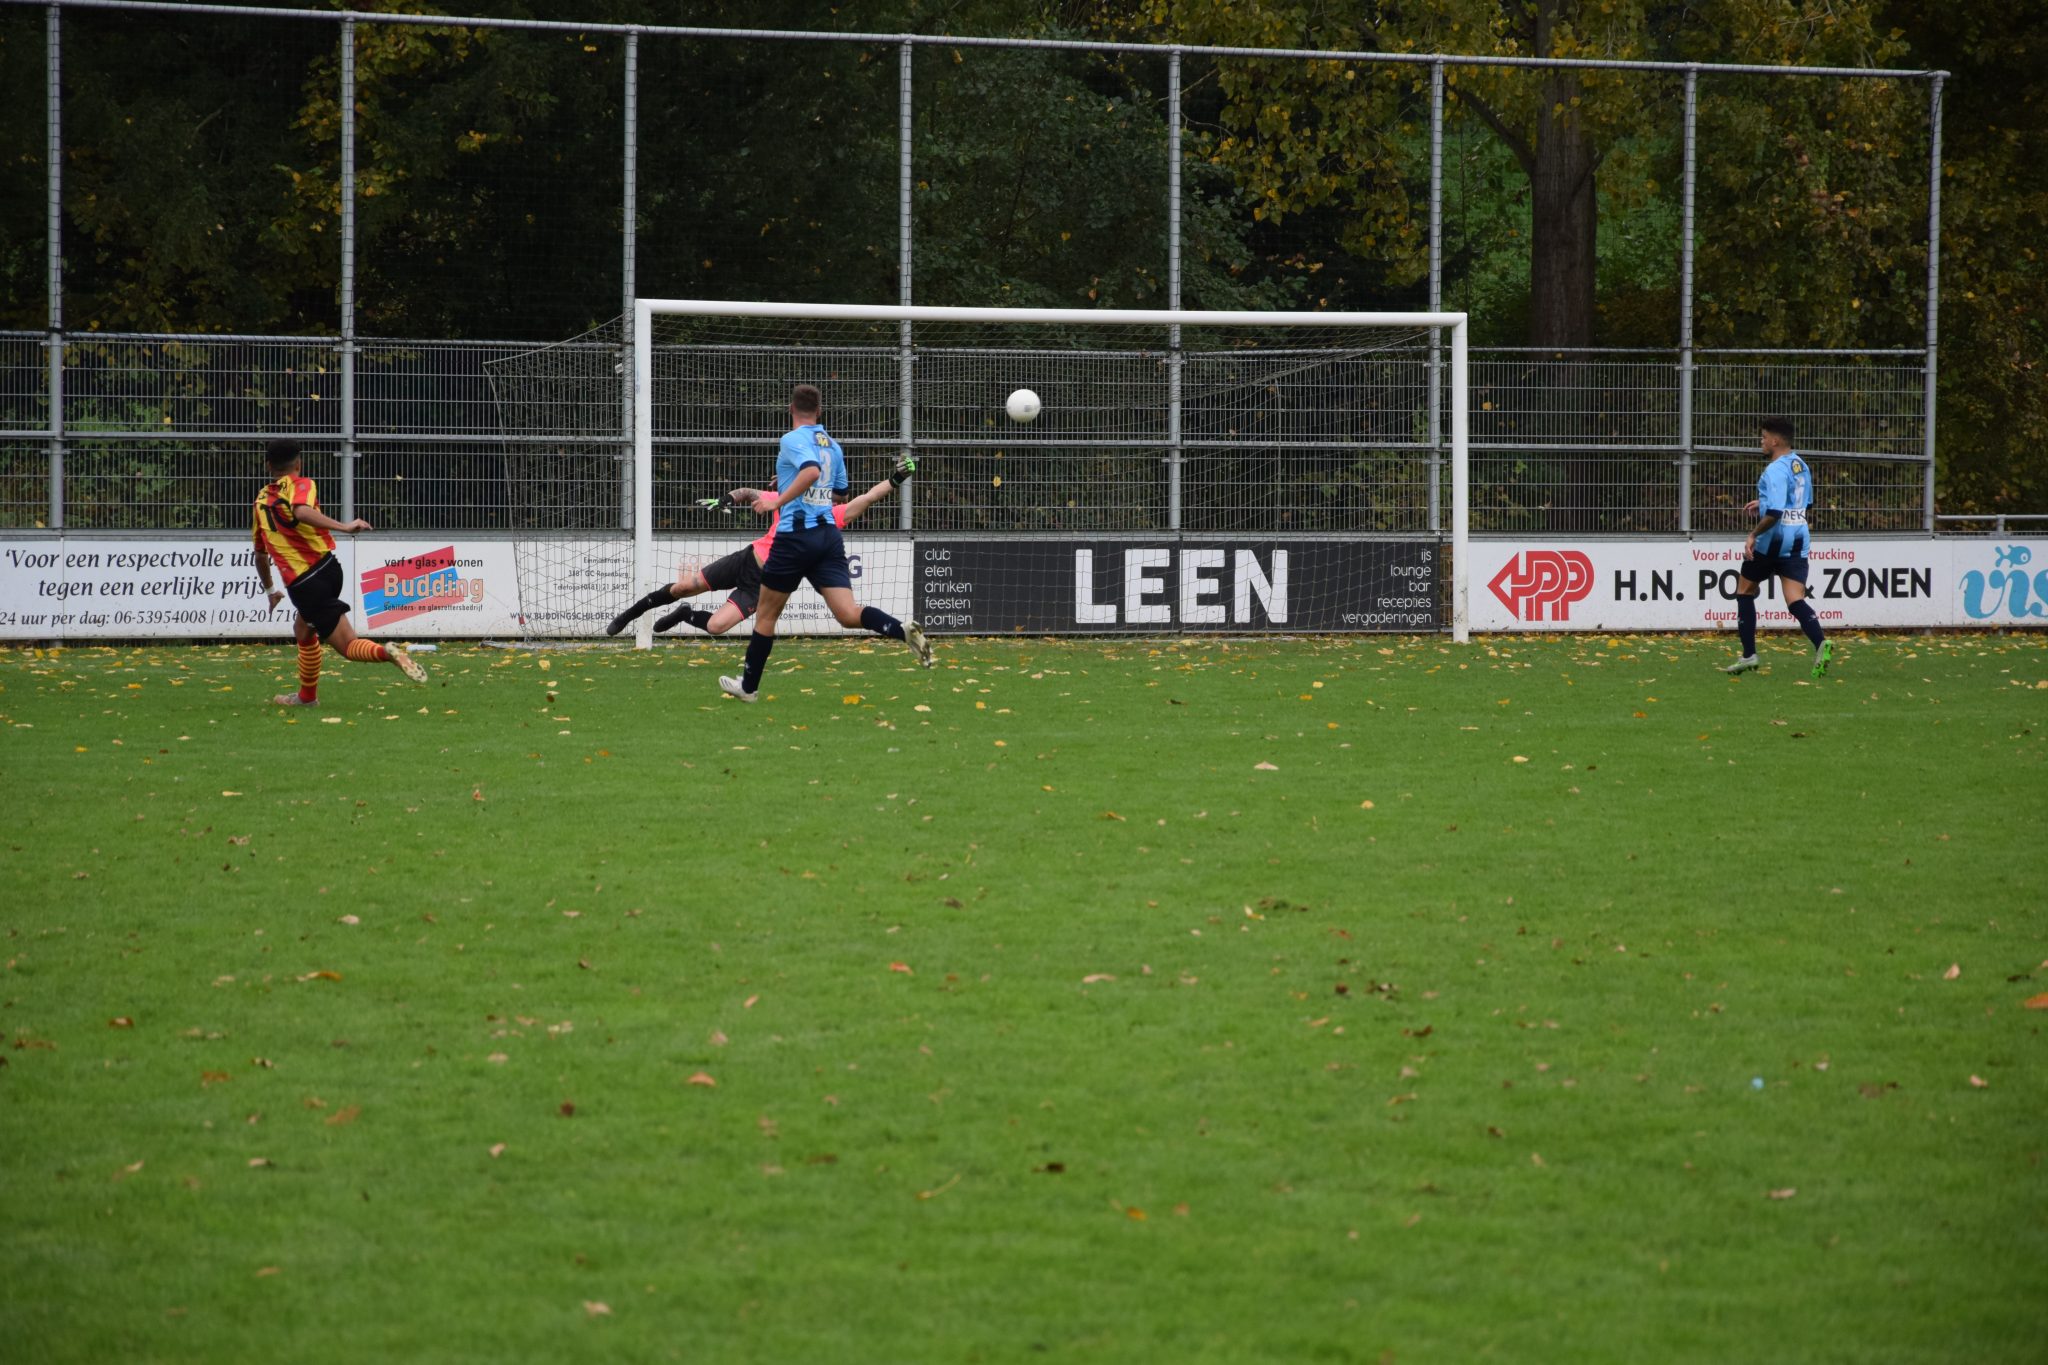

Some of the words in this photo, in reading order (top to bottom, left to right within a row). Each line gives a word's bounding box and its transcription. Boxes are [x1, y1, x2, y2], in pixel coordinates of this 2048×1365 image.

[260, 498, 299, 532] 10
[65, 553, 100, 568] een
[106, 548, 224, 571] respectvolle
[924, 547, 951, 561] club
[1420, 548, 1432, 563] ijs
[1692, 549, 1720, 562] Voor
[1722, 548, 1732, 561] al
[1808, 548, 1855, 563] trucking
[384, 556, 405, 568] verf
[415, 556, 437, 569] glas
[447, 559, 483, 568] wonen
[924, 564, 953, 577] eten
[1390, 564, 1432, 579] lounge
[38, 580, 94, 601] tegen
[100, 581, 134, 597] een
[141, 576, 215, 600] eerlijke
[383, 573, 484, 604] Budding
[924, 580, 972, 593] drinken
[1075, 548, 1289, 624] LEEN
[1408, 580, 1432, 592] bar
[1614, 569, 1684, 602] H.N.
[1823, 567, 1932, 600] ZONEN
[924, 596, 971, 609] feesten
[1377, 596, 1432, 610] recepties
[0, 612, 17, 625] 24
[21, 613, 47, 626] uur
[51, 612, 77, 628] per
[79, 610, 111, 628] dag:
[114, 609, 207, 625] 06-53954008
[924, 612, 973, 628] partijen
[1341, 611, 1432, 626] vergaderingen
